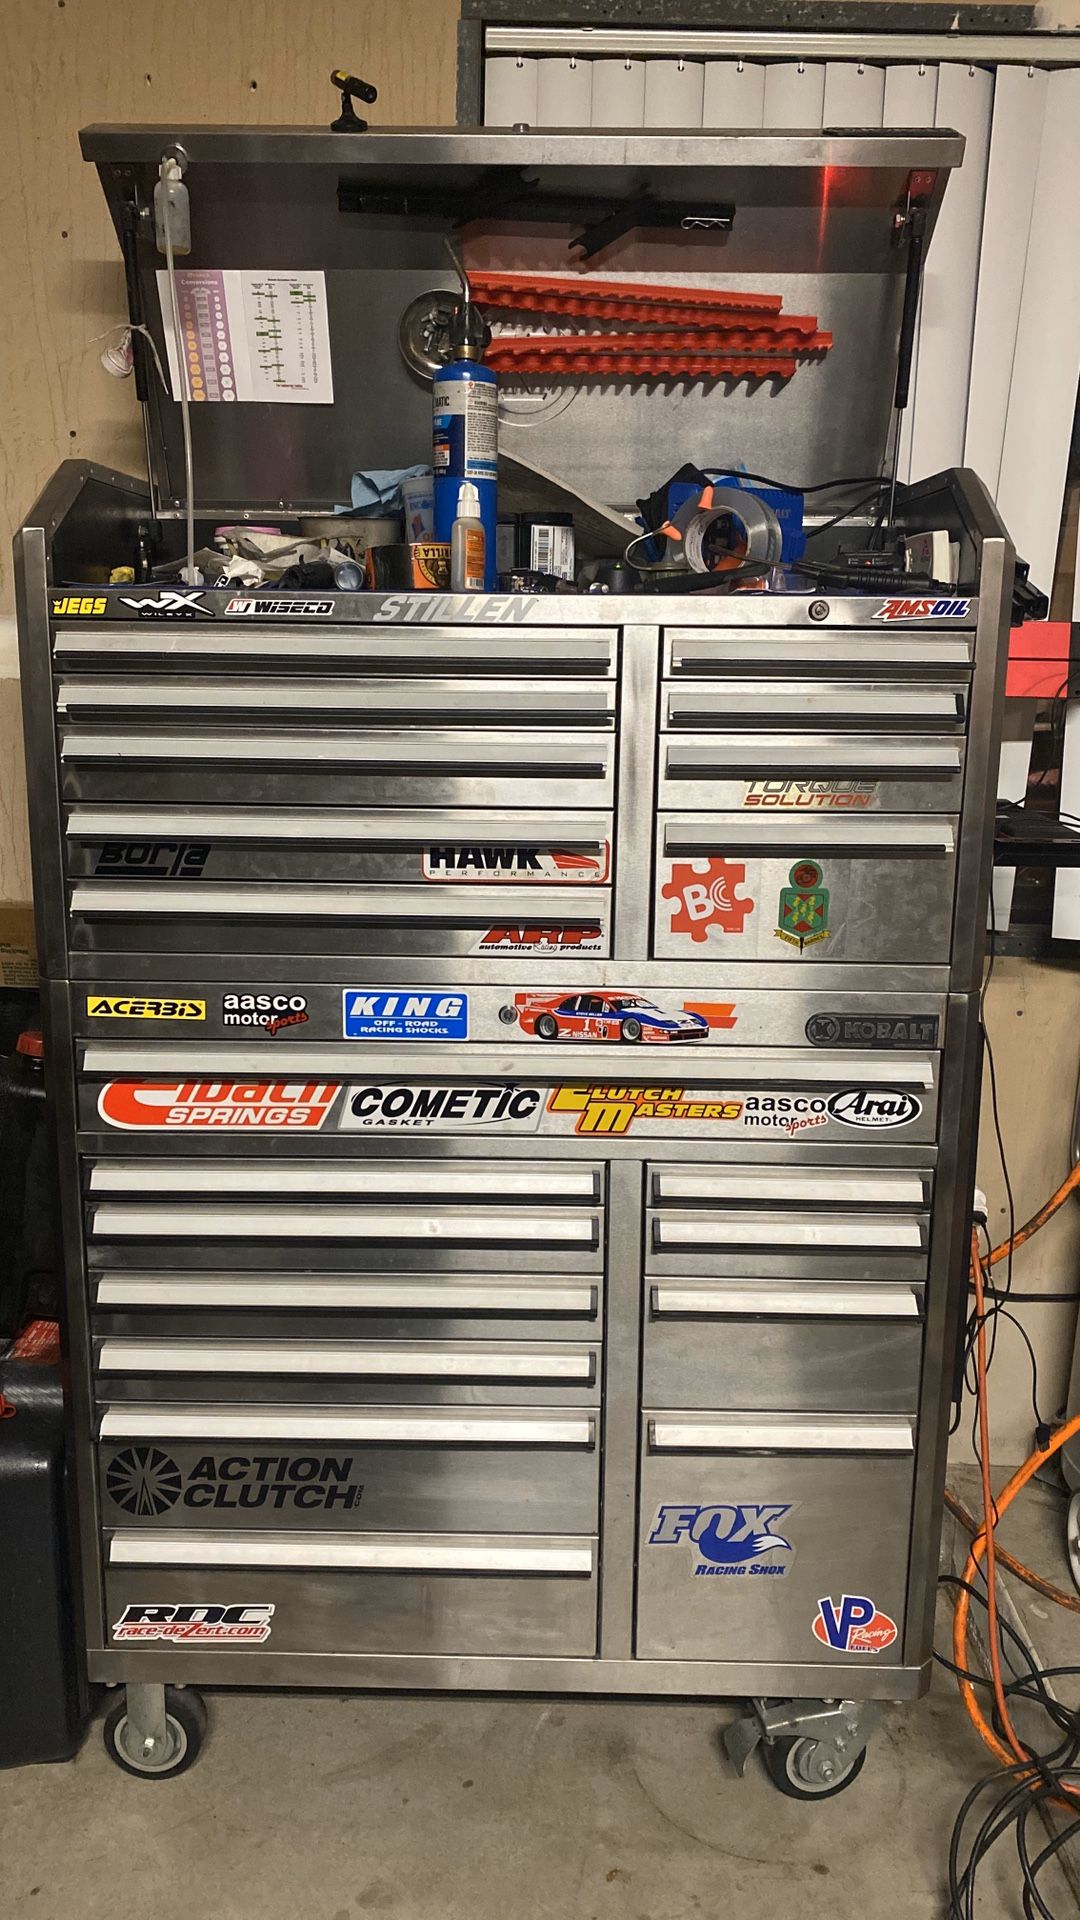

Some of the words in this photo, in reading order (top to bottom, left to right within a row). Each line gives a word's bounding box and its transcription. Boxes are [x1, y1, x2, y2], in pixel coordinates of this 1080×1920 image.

[53, 597, 107, 614] JEGS
[372, 596, 538, 621] STILLEN
[878, 599, 969, 618] AMSOIL
[744, 794, 872, 806] SOLUTION
[429, 847, 543, 869] HAWK
[480, 925, 602, 944] ARP
[223, 994, 306, 1011] aasco
[350, 997, 463, 1017] KING
[844, 1021, 934, 1040] KOBALT
[351, 1087, 541, 1119] COMETIC
[745, 1096, 826, 1113] aasco
[833, 1092, 908, 1116] Arai
[165, 1108, 311, 1125] SPRINGS
[579, 1102, 744, 1132] MASTERS
[187, 1457, 353, 1481] ACTION
[183, 1484, 357, 1508] CLUTCH
[649, 1504, 792, 1544] FOX
[121, 1606, 270, 1624] RDC
[819, 1596, 875, 1650] VP
